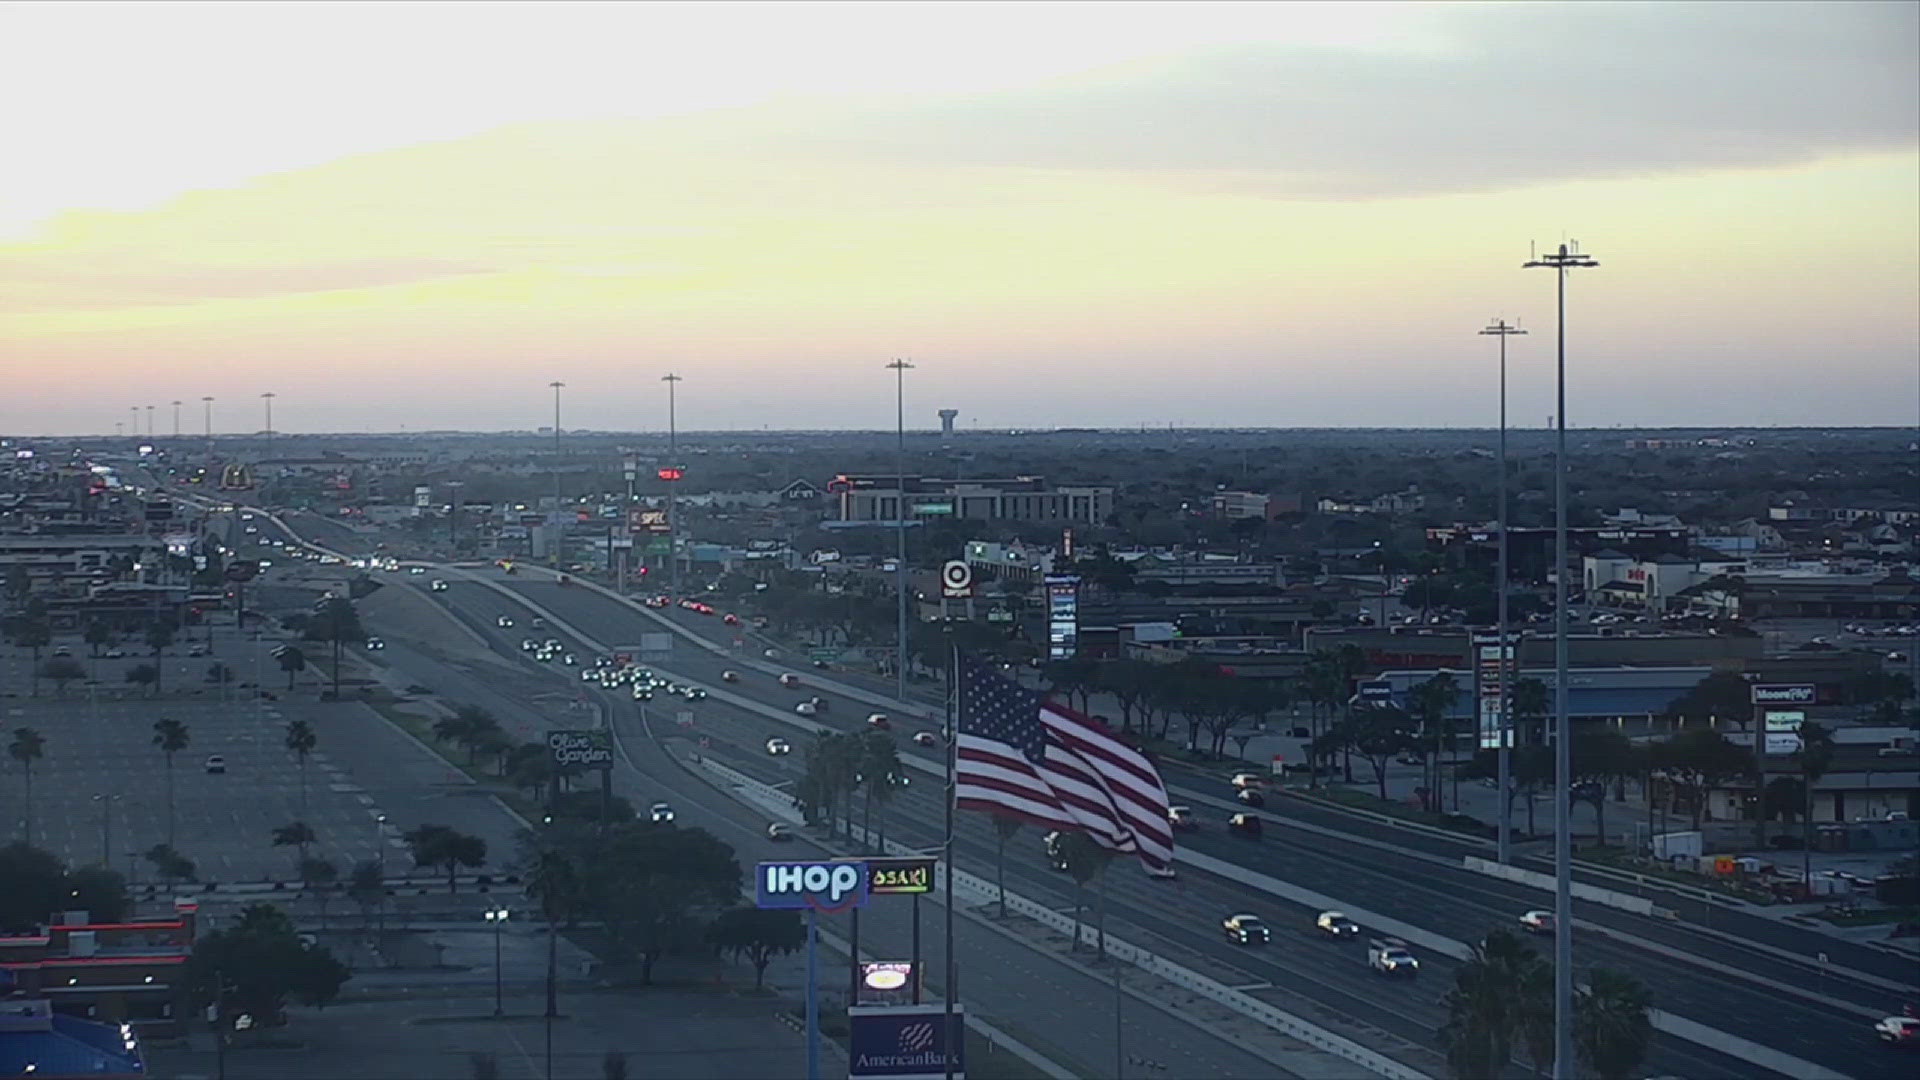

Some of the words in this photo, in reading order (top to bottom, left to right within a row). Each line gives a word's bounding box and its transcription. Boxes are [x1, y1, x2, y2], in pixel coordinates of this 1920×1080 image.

[549, 733, 590, 749] Olive
[555, 747, 611, 766] Garden
[766, 864, 858, 902] IHOP
